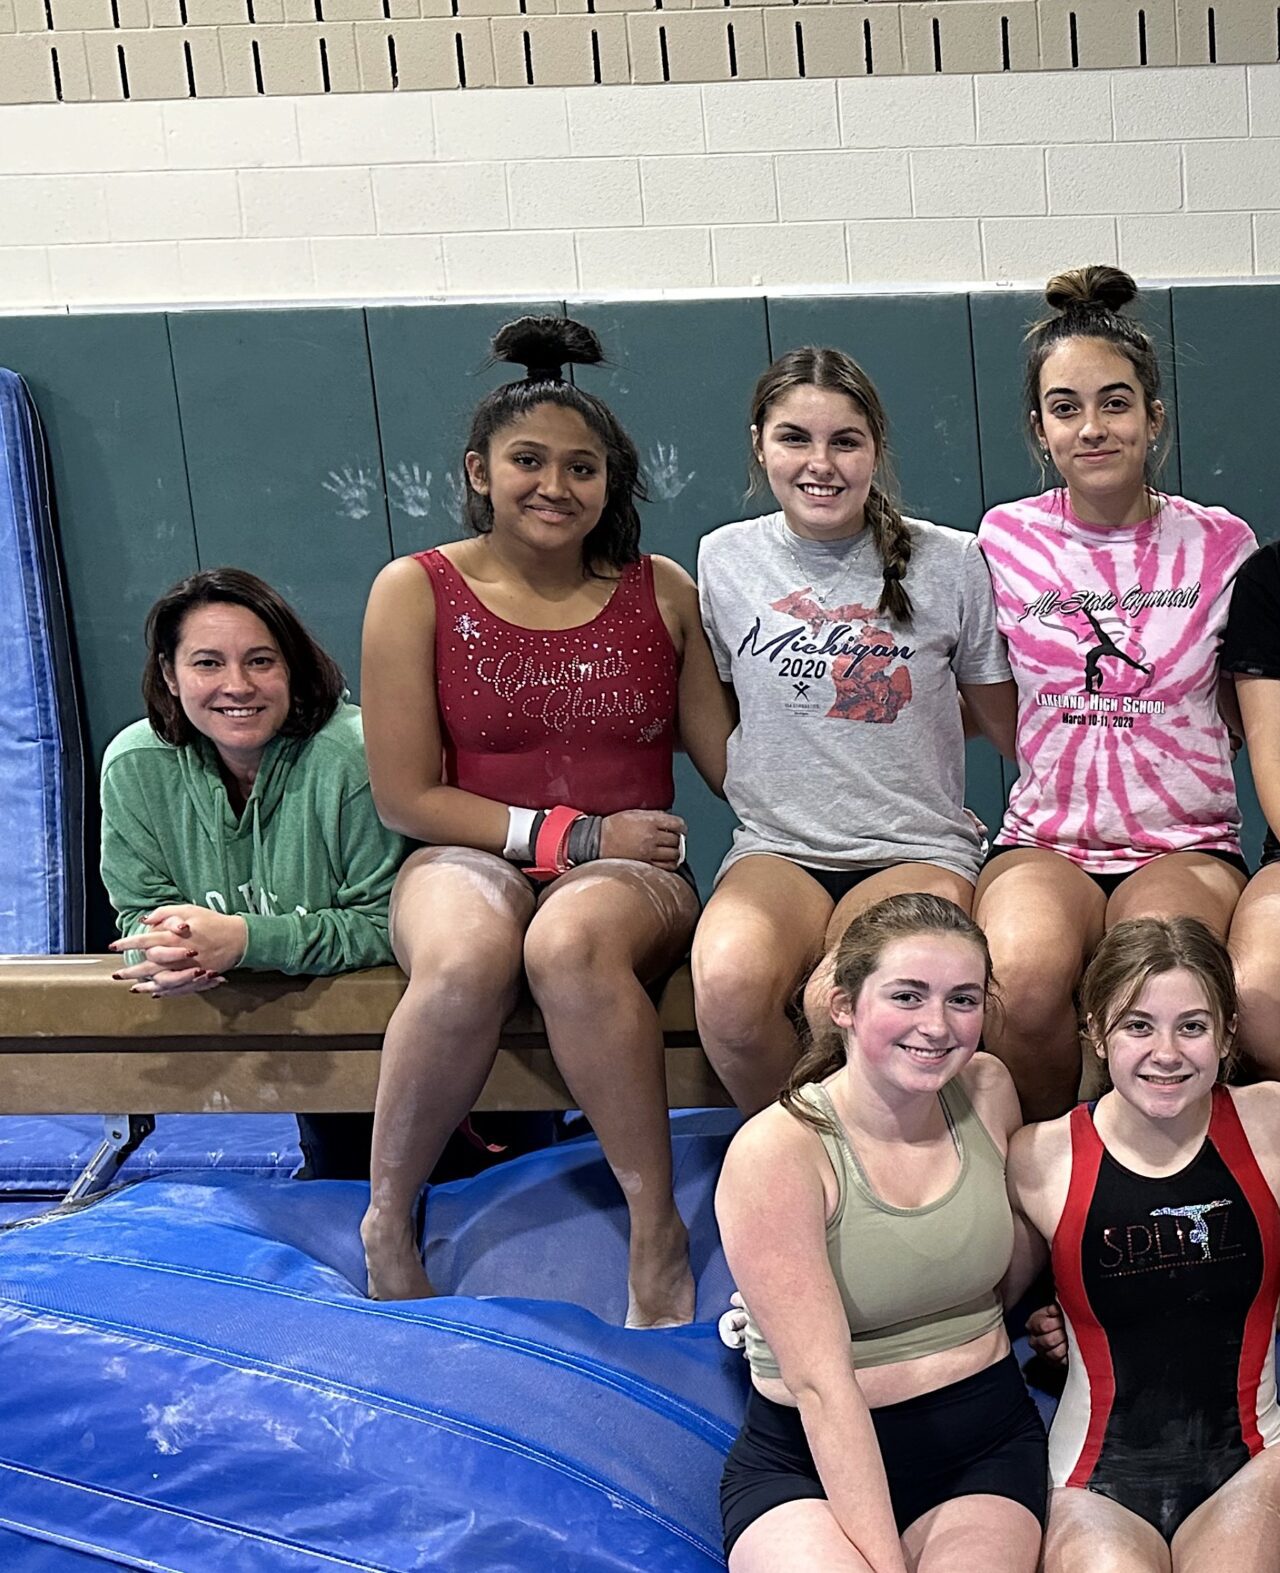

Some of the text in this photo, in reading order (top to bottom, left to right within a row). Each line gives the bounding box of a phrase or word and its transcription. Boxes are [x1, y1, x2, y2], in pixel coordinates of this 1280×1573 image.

[1017, 581, 1202, 622] All-State Gymnast
[737, 616, 916, 678] Michigan
[476, 650, 632, 704] Christmas
[778, 657, 828, 680] 2020
[521, 685, 648, 732] Classic
[1035, 691, 1167, 715] LAKELAND HIGH SCHOOL
[1062, 712, 1135, 729] March 10-11, 2023
